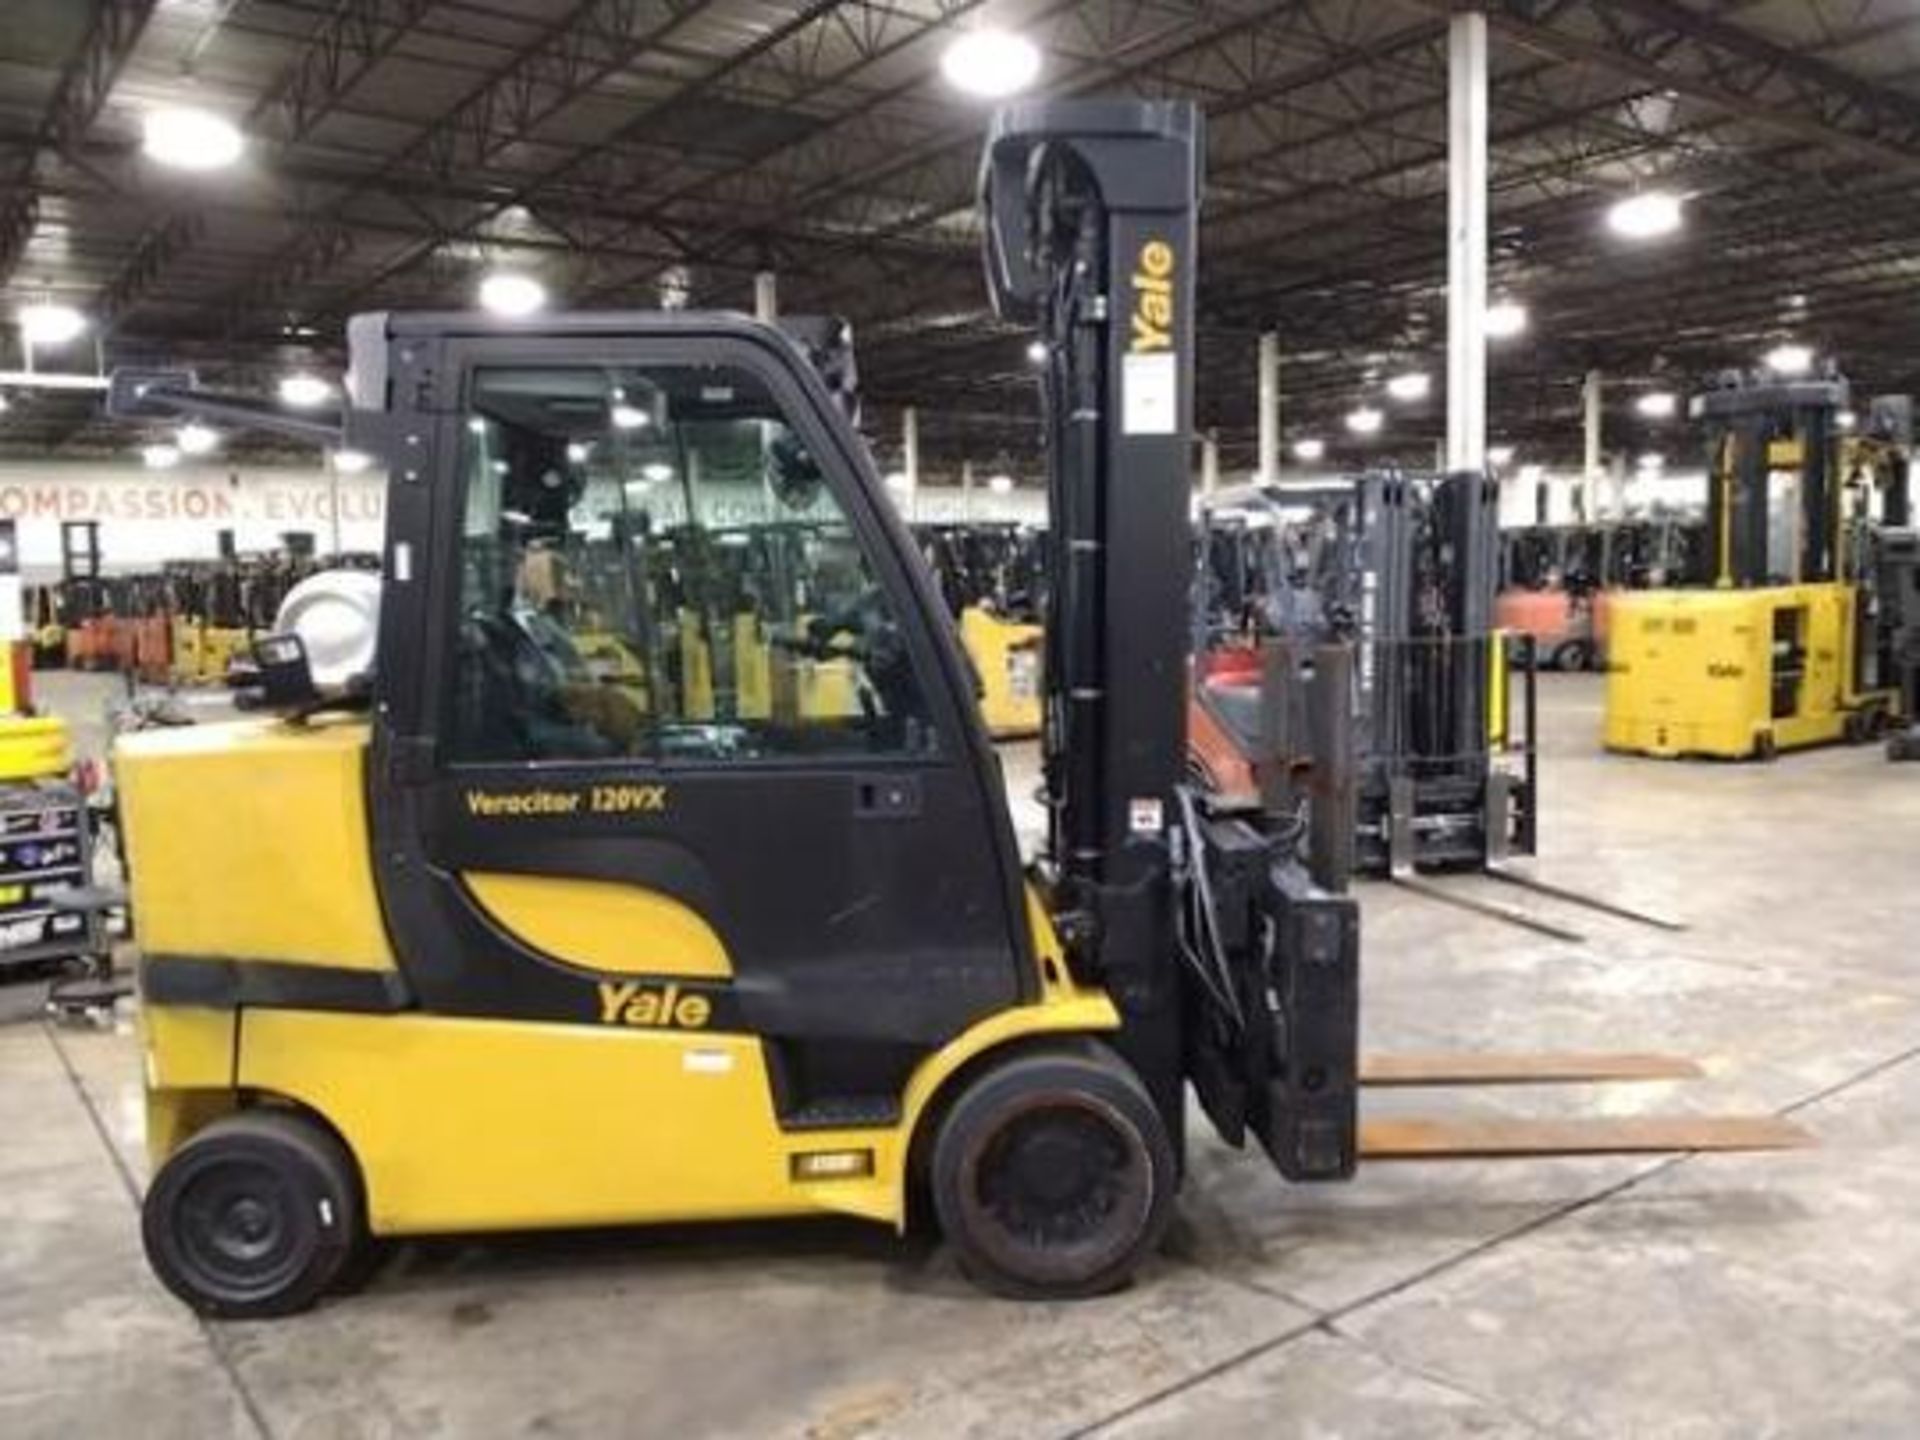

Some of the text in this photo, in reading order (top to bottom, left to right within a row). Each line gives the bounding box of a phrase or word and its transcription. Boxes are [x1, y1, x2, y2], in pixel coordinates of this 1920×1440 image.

[1131, 240, 1172, 351] Yale
[591, 785, 667, 811] 120VX
[598, 982, 711, 1026] Yale
